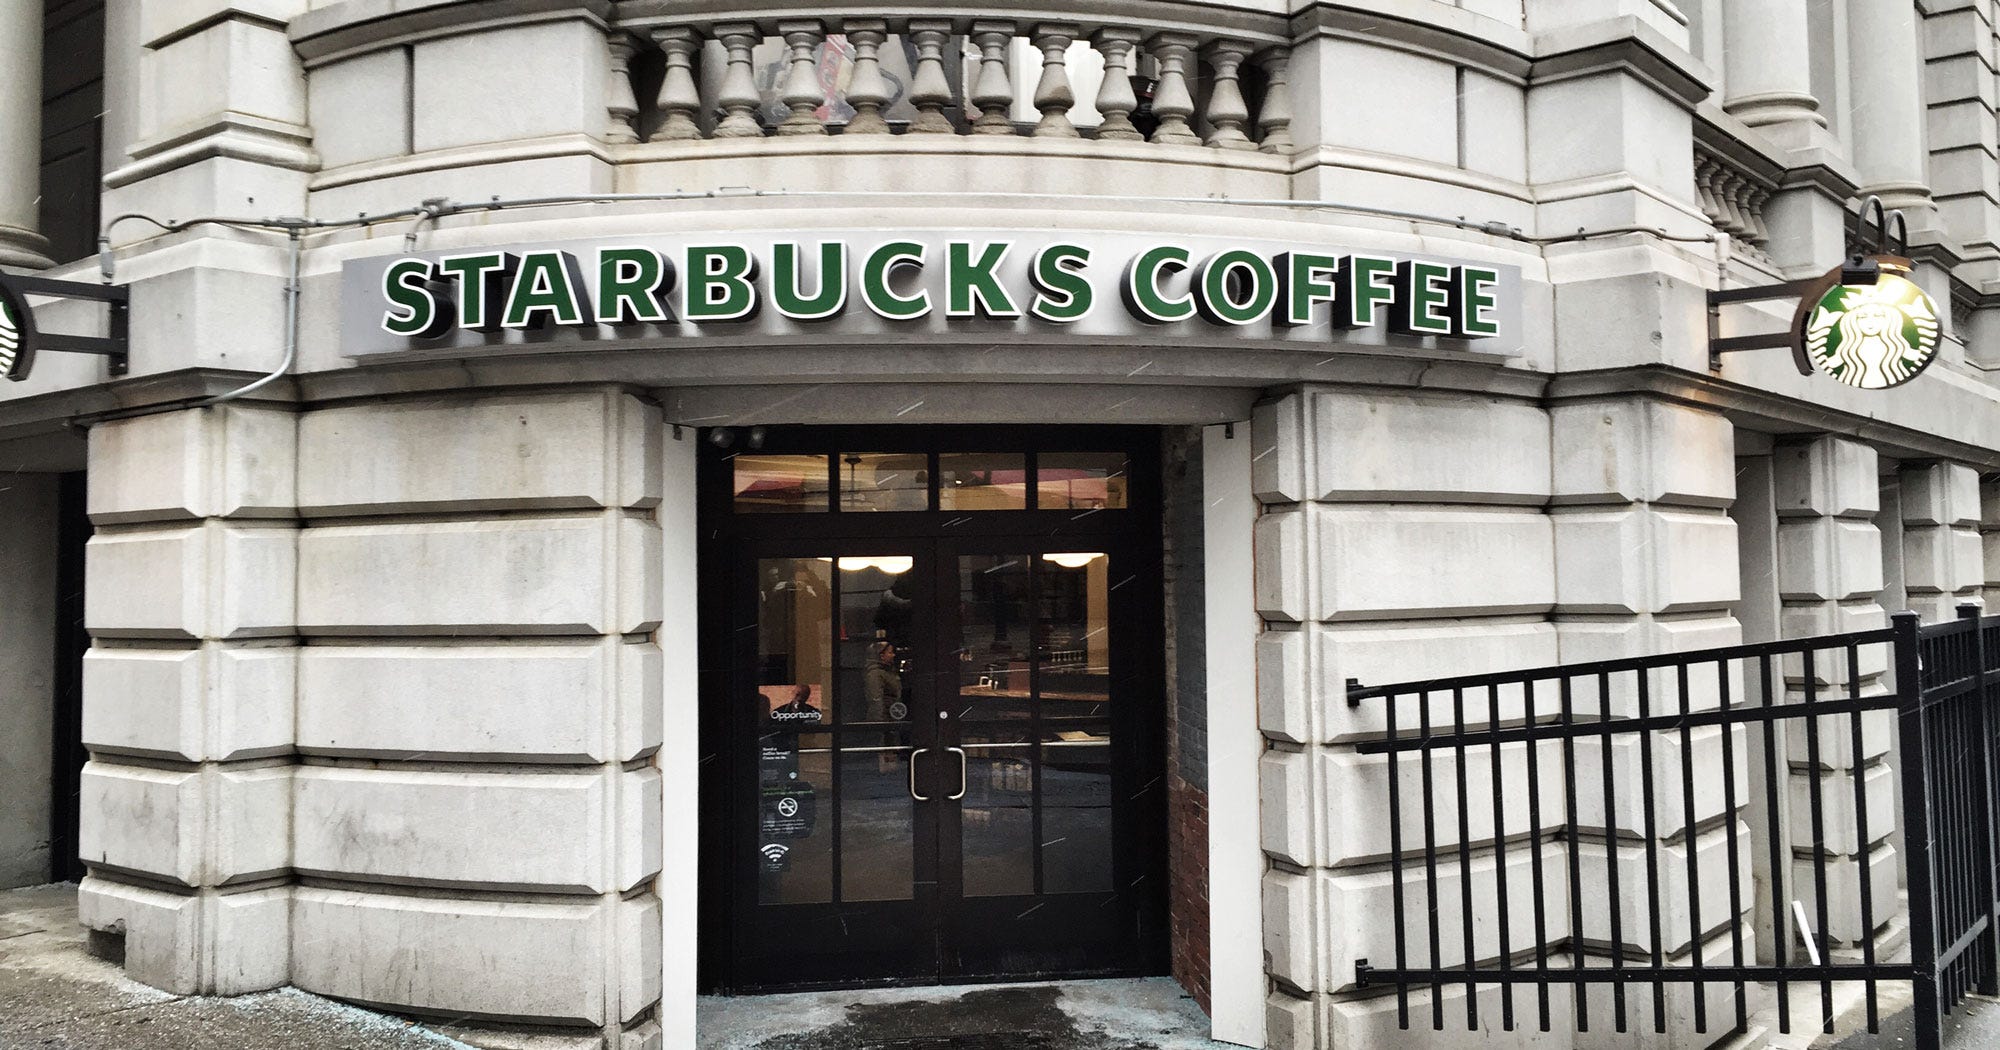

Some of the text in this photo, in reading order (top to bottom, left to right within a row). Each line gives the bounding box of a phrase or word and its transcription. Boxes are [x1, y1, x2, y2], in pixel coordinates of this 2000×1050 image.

[381, 239, 1500, 338] STARBUCKS COFFEE
[771, 710, 822, 721] Opportunity
